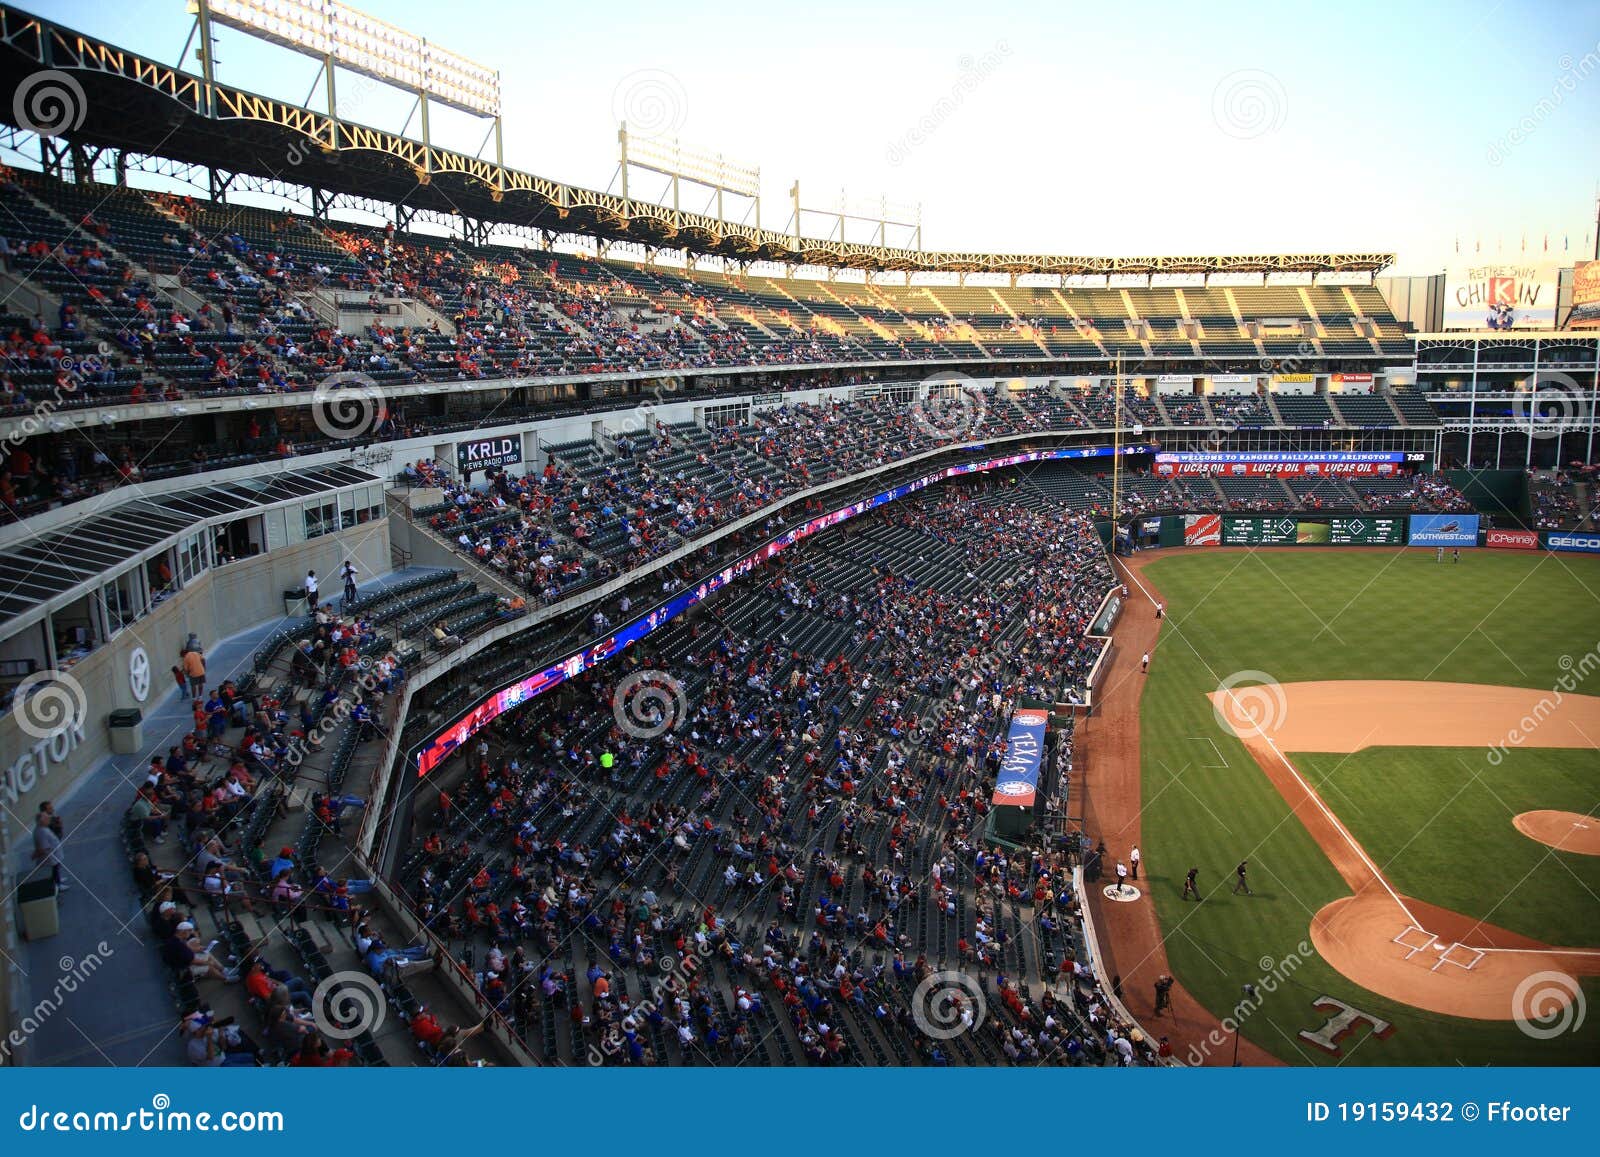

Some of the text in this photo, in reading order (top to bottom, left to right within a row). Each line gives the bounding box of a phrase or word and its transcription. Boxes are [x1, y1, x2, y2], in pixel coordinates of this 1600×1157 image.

[467, 439, 513, 461] KRLD
[484, 457, 502, 467] RADIO
[1407, 453, 1425, 461] 7:02
[1178, 463, 1209, 472] LUCAS
[1284, 463, 1300, 472] OIL
[1324, 463, 1355, 472] LUCAS
[1356, 463, 1372, 472] OIL
[1487, 534, 1536, 545] JCPenney
[1548, 536, 1600, 548] GEICO
[1003, 731, 1038, 773] TEXAS
